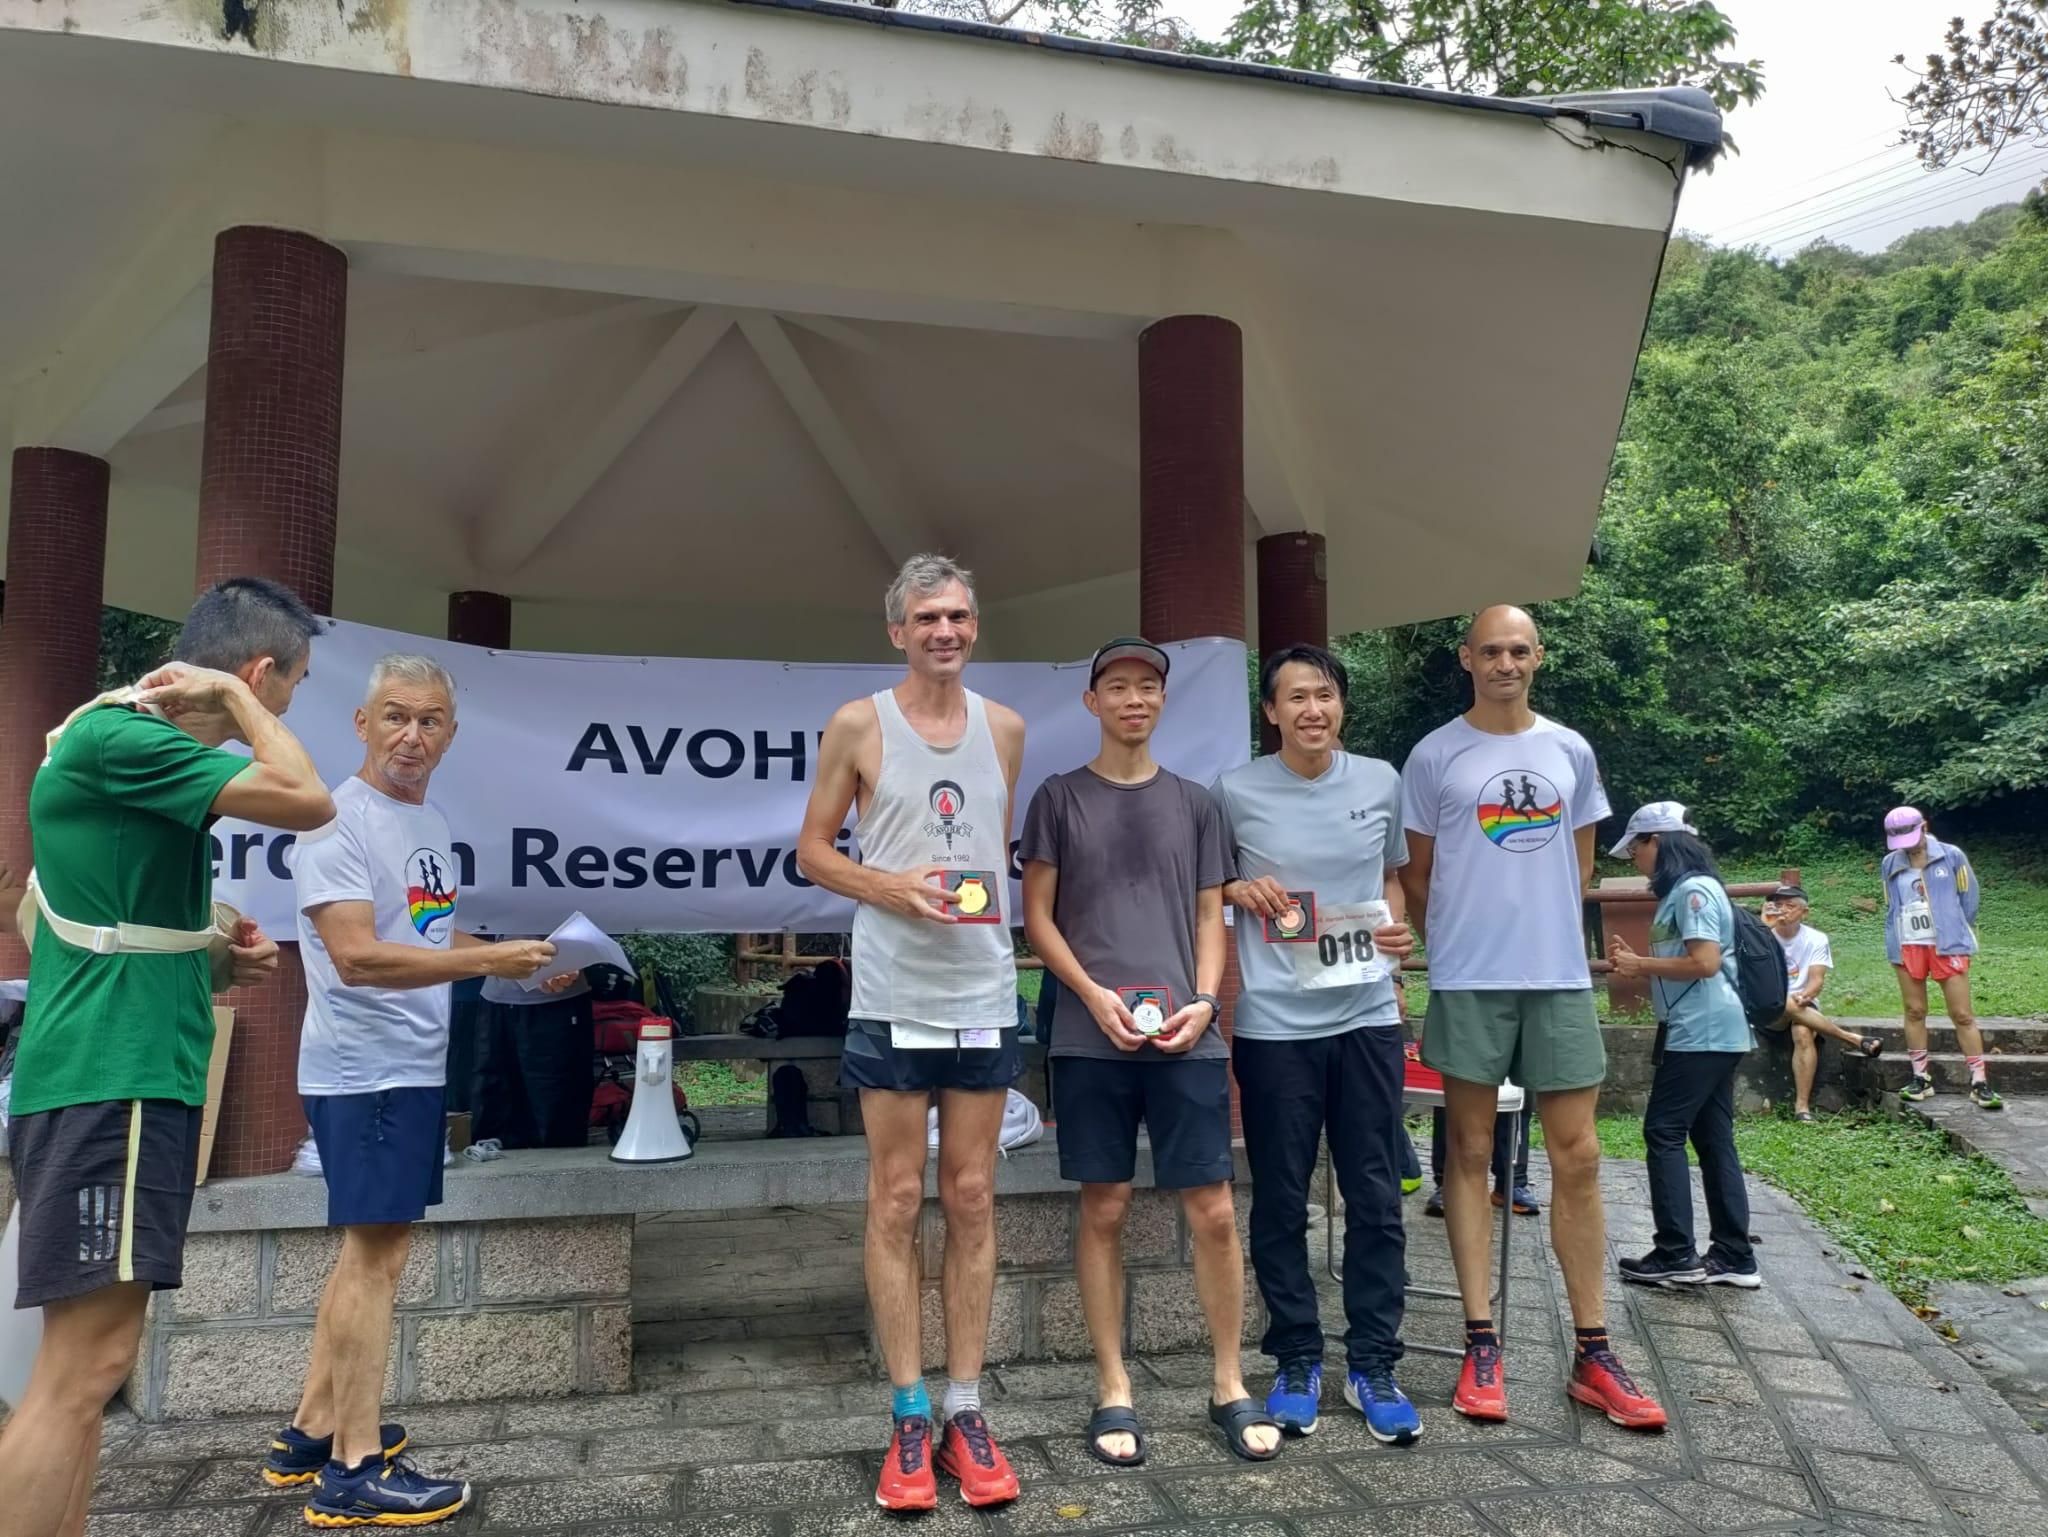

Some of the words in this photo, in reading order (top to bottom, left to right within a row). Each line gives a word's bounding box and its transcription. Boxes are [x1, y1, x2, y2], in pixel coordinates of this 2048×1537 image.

[565, 722, 824, 782] AVOH
[511, 827, 863, 889] Reservo
[1318, 929, 1374, 967] 018
